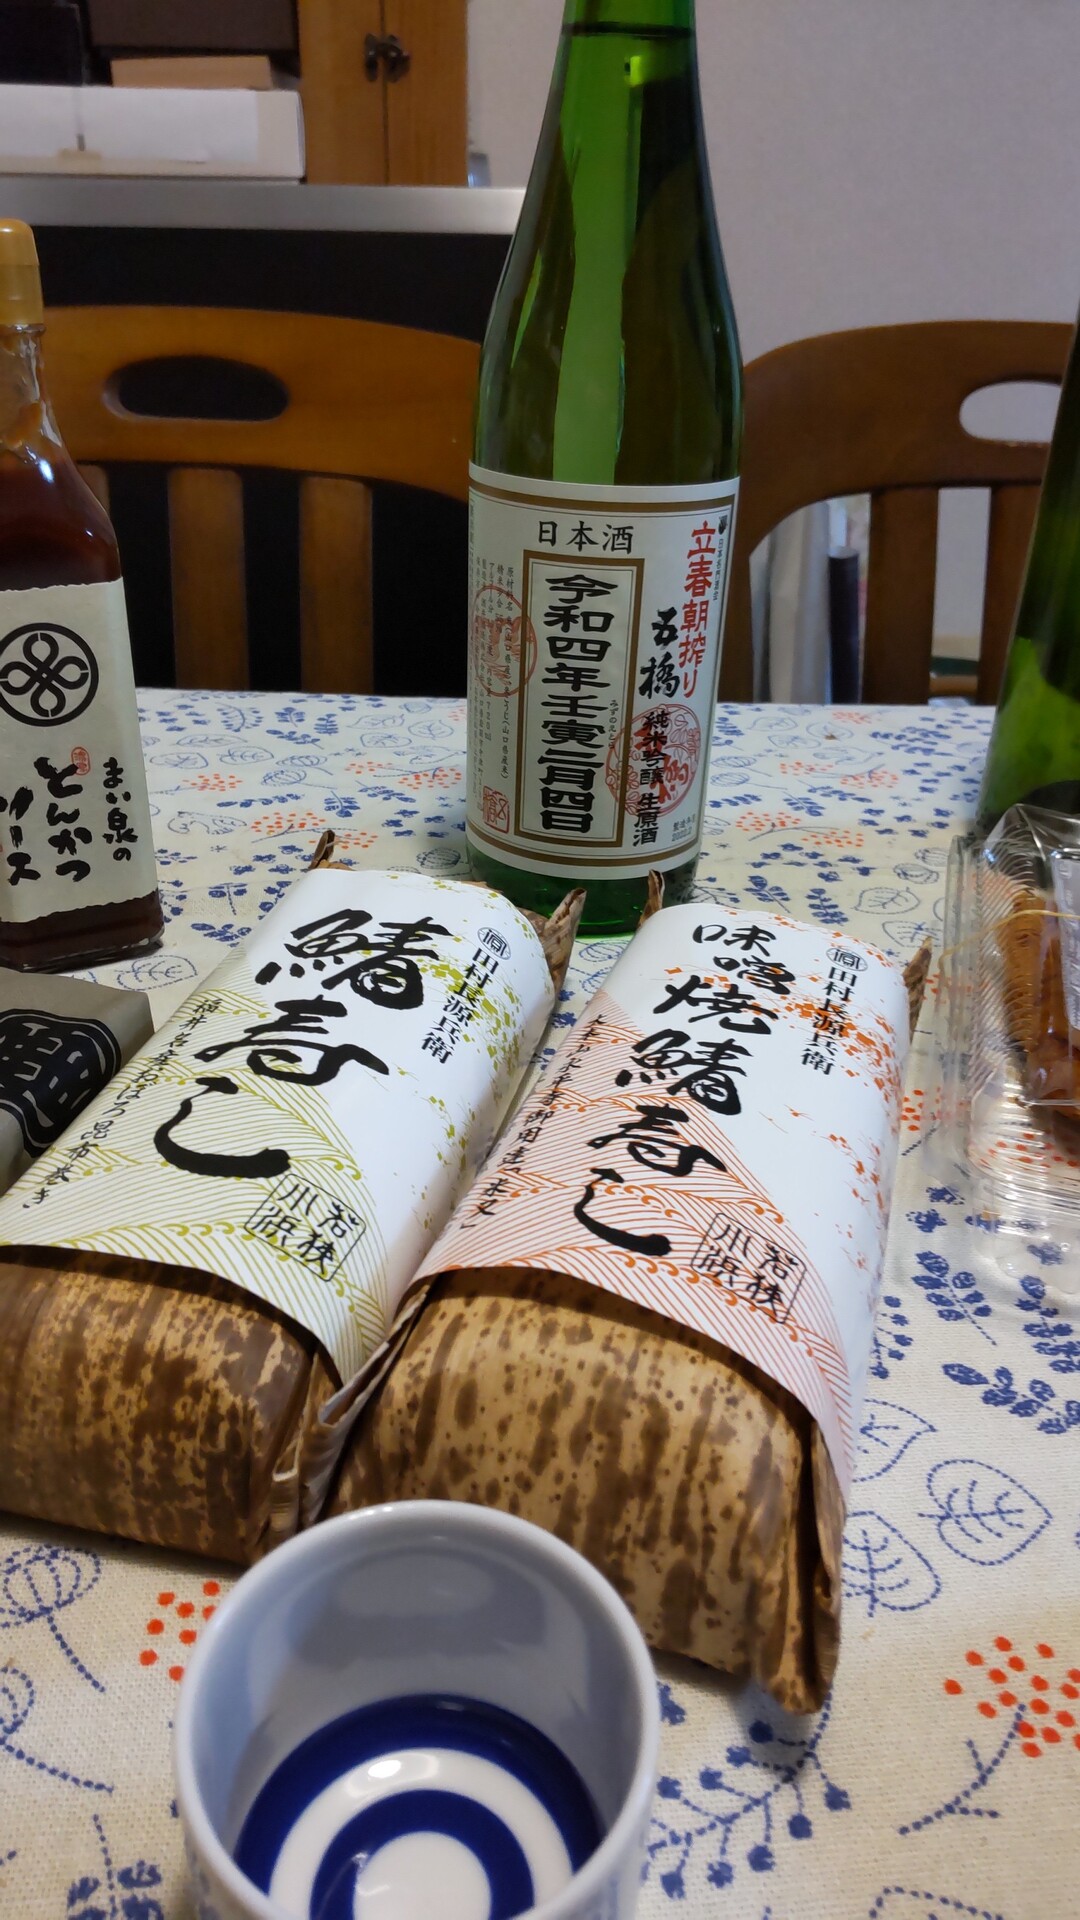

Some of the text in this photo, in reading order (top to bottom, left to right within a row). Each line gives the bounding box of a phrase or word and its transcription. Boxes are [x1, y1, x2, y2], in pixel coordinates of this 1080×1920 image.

[537, 520, 635, 555] 日本酒
[638, 607, 682, 700] 五橋
[679, 519, 717, 700] 立春朝搾り
[537, 573, 618, 834] 令和四年壬寅二月四日
[639, 710, 671, 785] 純米吟醸
[33, 756, 92, 882] とんかつ
[101, 757, 139, 862] まい泉の
[632, 792, 663, 848] 生原酒
[153, 908, 453, 1179] 鯖寿し
[420, 946, 500, 1065] 田村長源兵衛
[799, 966, 858, 1076] 田村長源兵衛
[573, 924, 797, 1257] 味噌焼鯖寿し
